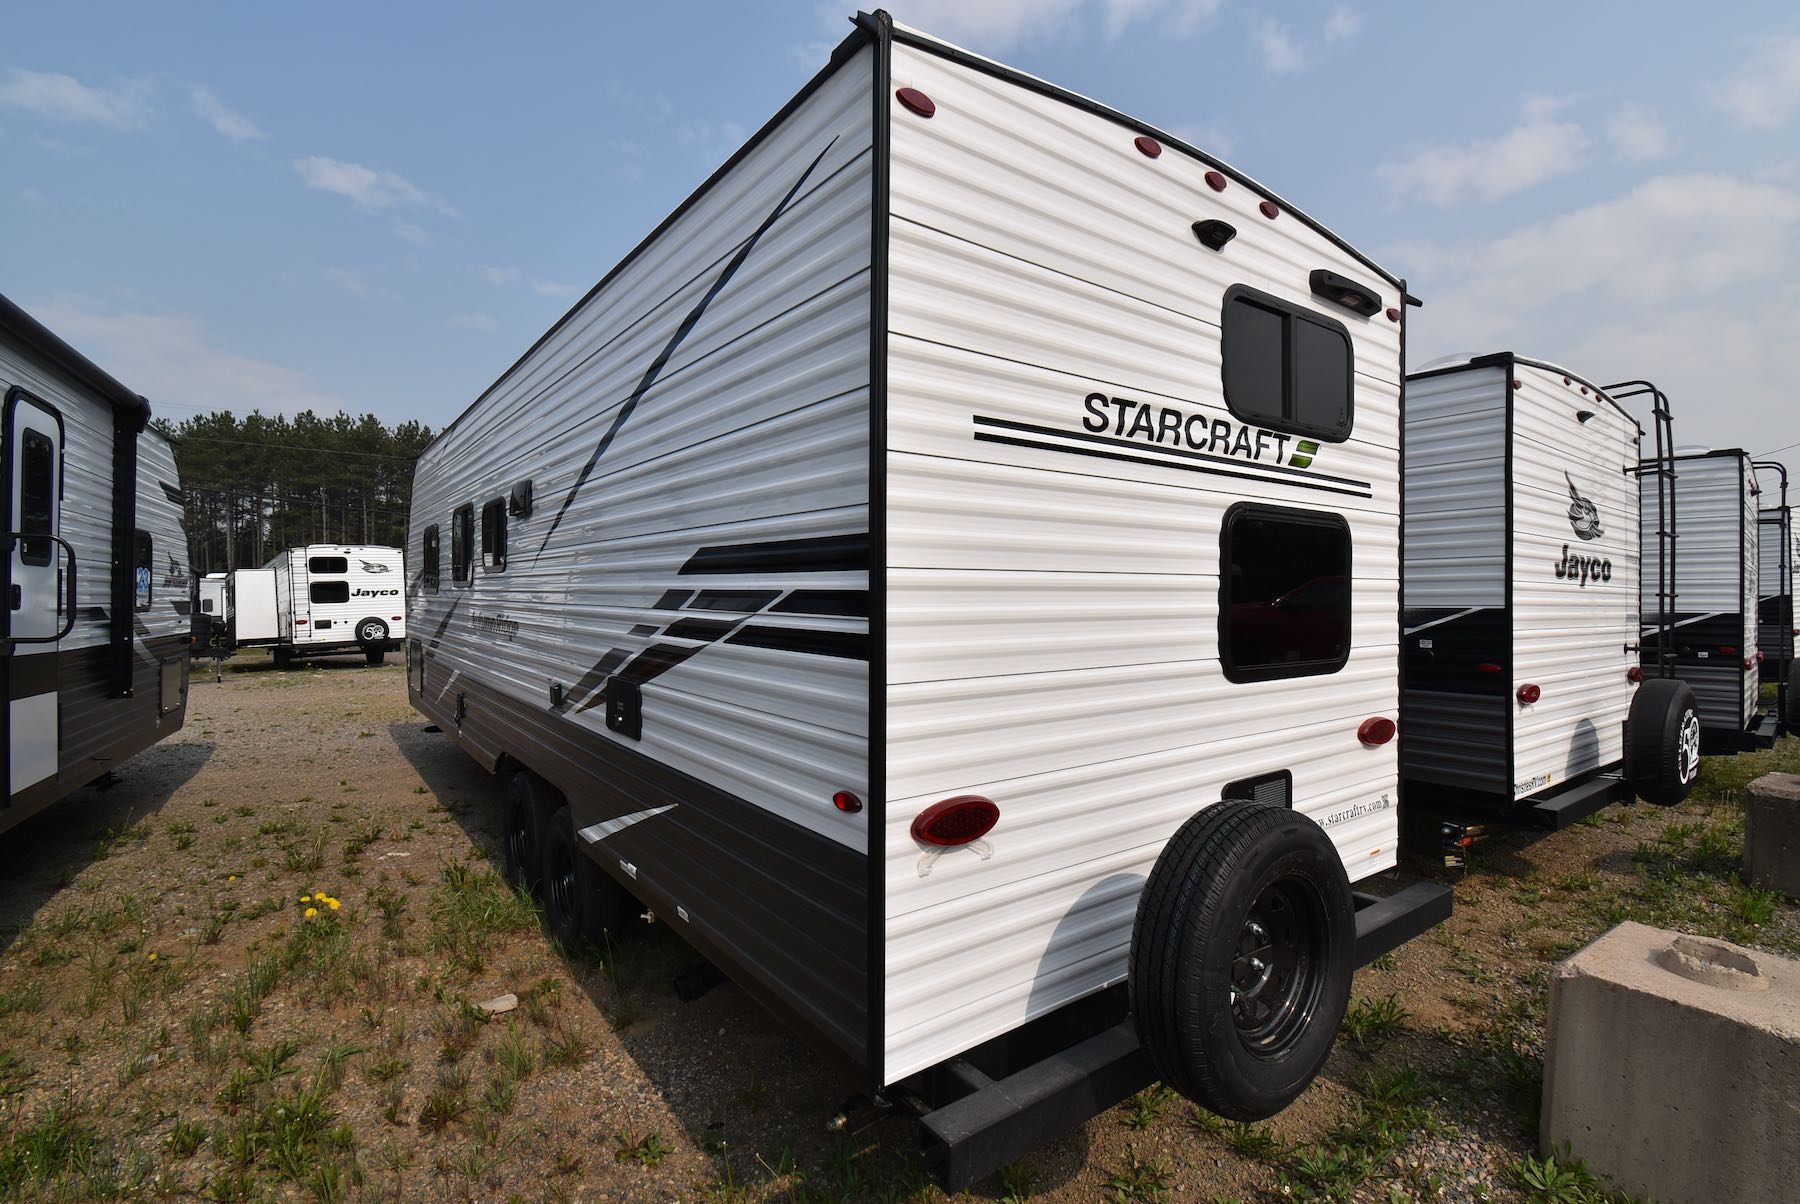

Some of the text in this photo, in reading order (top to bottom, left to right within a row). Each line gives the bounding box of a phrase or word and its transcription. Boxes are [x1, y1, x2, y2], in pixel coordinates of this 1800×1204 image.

[1083, 393, 1291, 465] STARCRAFT
[1555, 543, 1612, 589] Jayco
[351, 588, 399, 598] Jayco
[1317, 799, 1382, 827] w.starcraftrv.com
